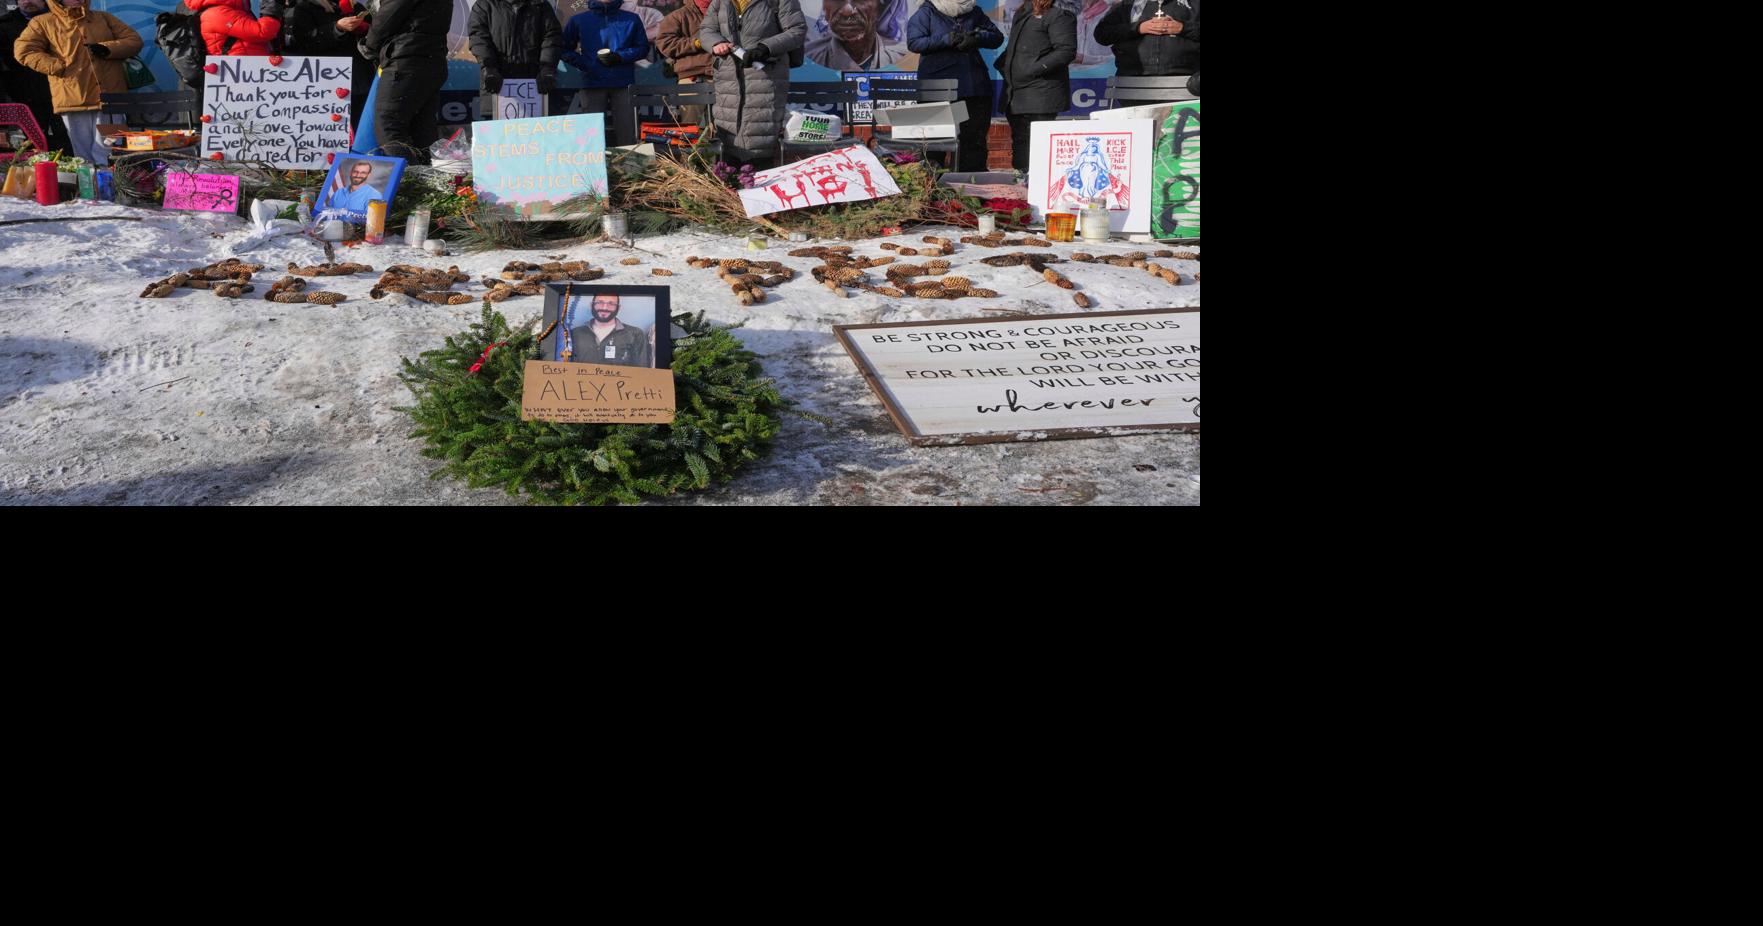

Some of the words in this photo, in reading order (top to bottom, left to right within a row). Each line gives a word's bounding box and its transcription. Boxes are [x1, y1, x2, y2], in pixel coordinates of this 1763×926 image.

[219, 58, 289, 83] Nurse
[293, 57, 351, 83] Alex
[207, 84, 266, 103] Thank
[269, 90, 299, 106] you
[300, 85, 332, 100] for
[503, 81, 537, 99] ICE
[207, 102, 254, 122] Your
[256, 102, 351, 120] Compassion
[504, 102, 537, 121] OUT
[208, 124, 243, 135] and
[249, 120, 294, 135] Love
[295, 117, 350, 133] toward
[503, 118, 577, 138] PEACE
[801, 120, 829, 131] HOME
[206, 135, 286, 152] Everyone
[291, 134, 315, 148] You
[317, 133, 349, 148] have
[474, 141, 541, 158] STEMS
[1056, 138, 1081, 147] HAIL
[1106, 138, 1127, 146] KICK
[235, 146, 292, 163] Cared
[295, 148, 323, 163] For
[545, 151, 604, 167] FROM
[499, 173, 585, 192] JUSTICE
[872, 334, 902, 344] BE
[906, 329, 1002, 342] STRONG
[1007, 329, 1020, 337] &
[1023, 320, 1181, 337] COURAGEOUS
[926, 344, 962, 353] DO
[968, 341, 1017, 351] NOT
[1024, 339, 1057, 349] BE
[1063, 335, 1145, 348] AFRAID
[1039, 351, 1077, 361] OR
[1080, 344, 1200, 359] DISCOURA
[594, 367, 623, 376] Peace
[905, 369, 957, 379] FOR
[961, 367, 1014, 378] THE
[1016, 364, 1085, 376] LORD
[1088, 360, 1163, 372] YOUR
[1029, 378, 1095, 389] WILL
[1099, 375, 1135, 386] BE
[1135, 371, 1200, 384] WITH
[540, 379, 608, 402] ALEX
[616, 380, 663, 401] Pretti
[976, 388, 1158, 414] wherever
